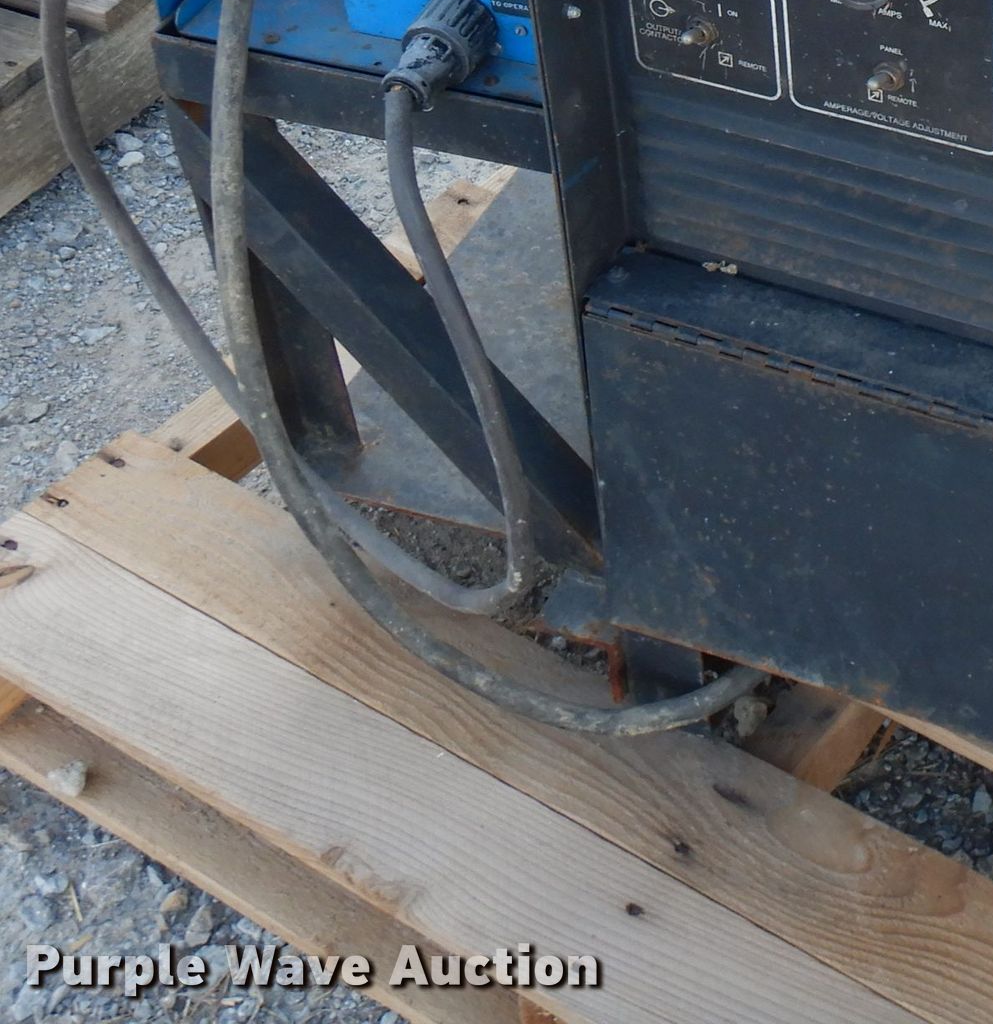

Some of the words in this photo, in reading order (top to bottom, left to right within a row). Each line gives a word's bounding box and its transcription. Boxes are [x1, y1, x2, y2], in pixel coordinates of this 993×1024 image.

[726, 9, 739, 18] ON
[878, 8, 903, 20] AMPS
[879, 44, 904, 56] PANEL
[738, 60, 768, 72] REMOTE
[887, 93, 918, 108] REMOTE
[823, 100, 911, 128] AMPERAGE/VOLTAGE
[912, 122, 969, 143] ADJUSTMENT
